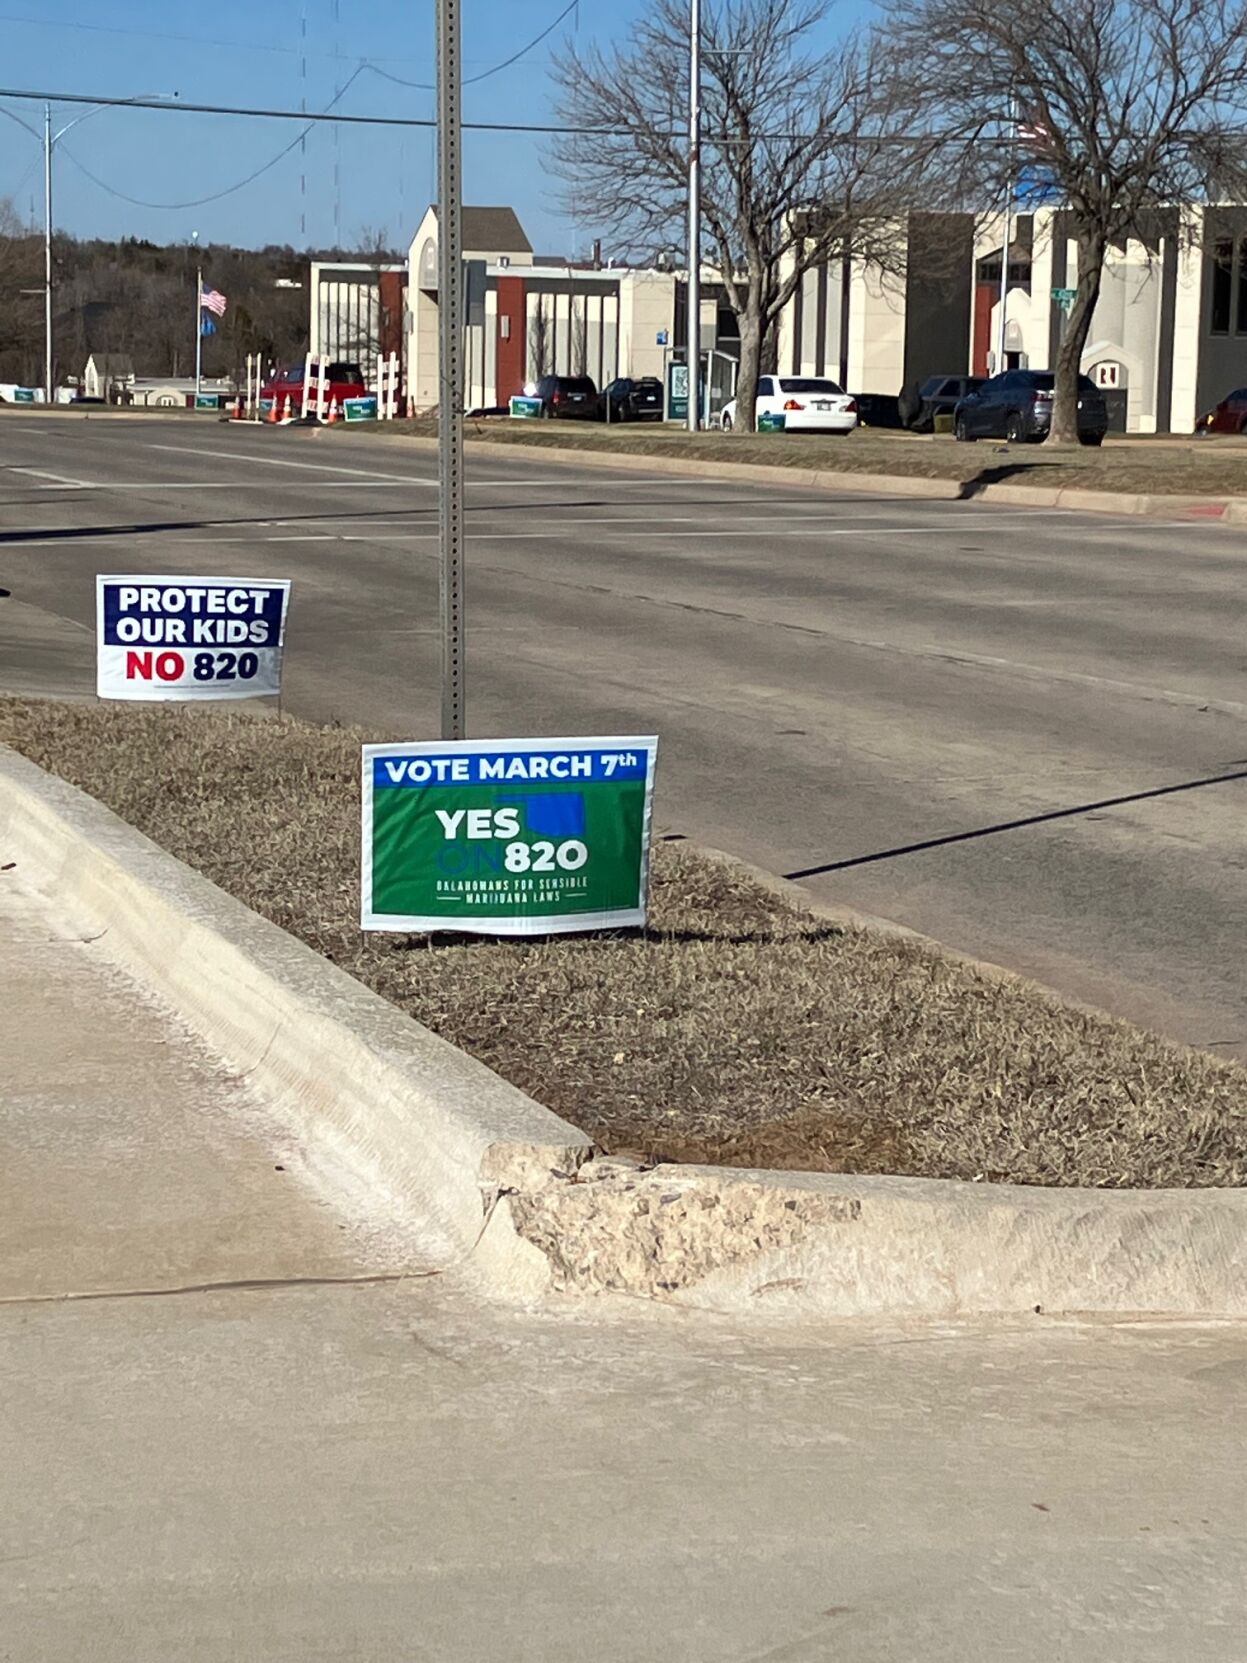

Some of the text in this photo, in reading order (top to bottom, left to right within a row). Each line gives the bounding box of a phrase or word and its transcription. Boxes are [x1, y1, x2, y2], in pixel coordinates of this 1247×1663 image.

[119, 587, 270, 614] PROTECT
[116, 617, 269, 643] OUR KIDS
[126, 651, 259, 681] NO 820
[384, 753, 637, 783] VOTE MARCH 7th
[435, 807, 521, 840] YES
[436, 839, 588, 875] ON 820
[436, 876, 588, 891] OKLAHOMANS FOR SENSIBLE
[466, 891, 561, 905] MARIJUANA LAWS
